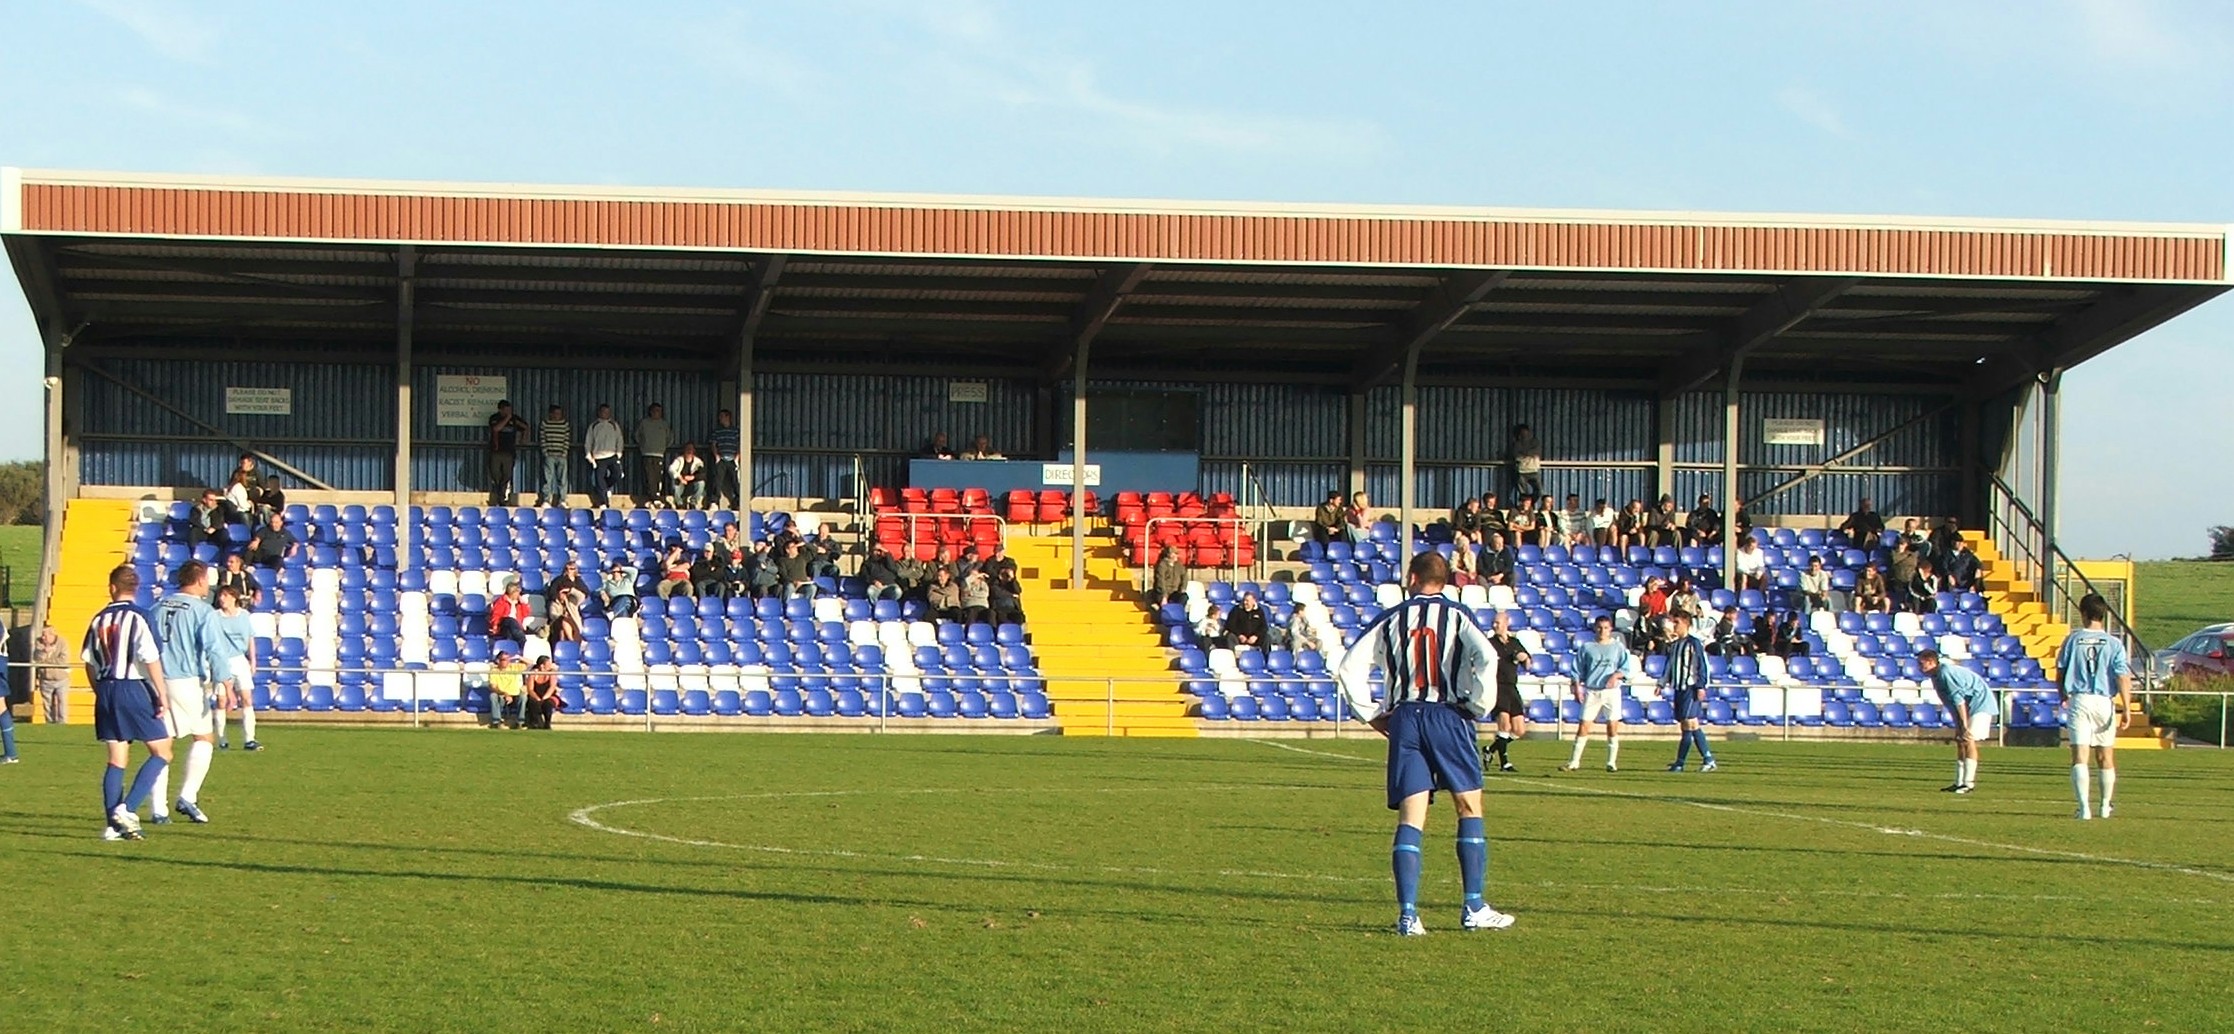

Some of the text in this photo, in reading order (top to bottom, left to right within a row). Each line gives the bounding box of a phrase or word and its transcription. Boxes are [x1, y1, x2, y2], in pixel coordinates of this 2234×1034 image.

[466, 377, 480, 386] NO
[951, 386, 985, 398] PRESS
[1045, 469, 1098, 480] DIRECRS
